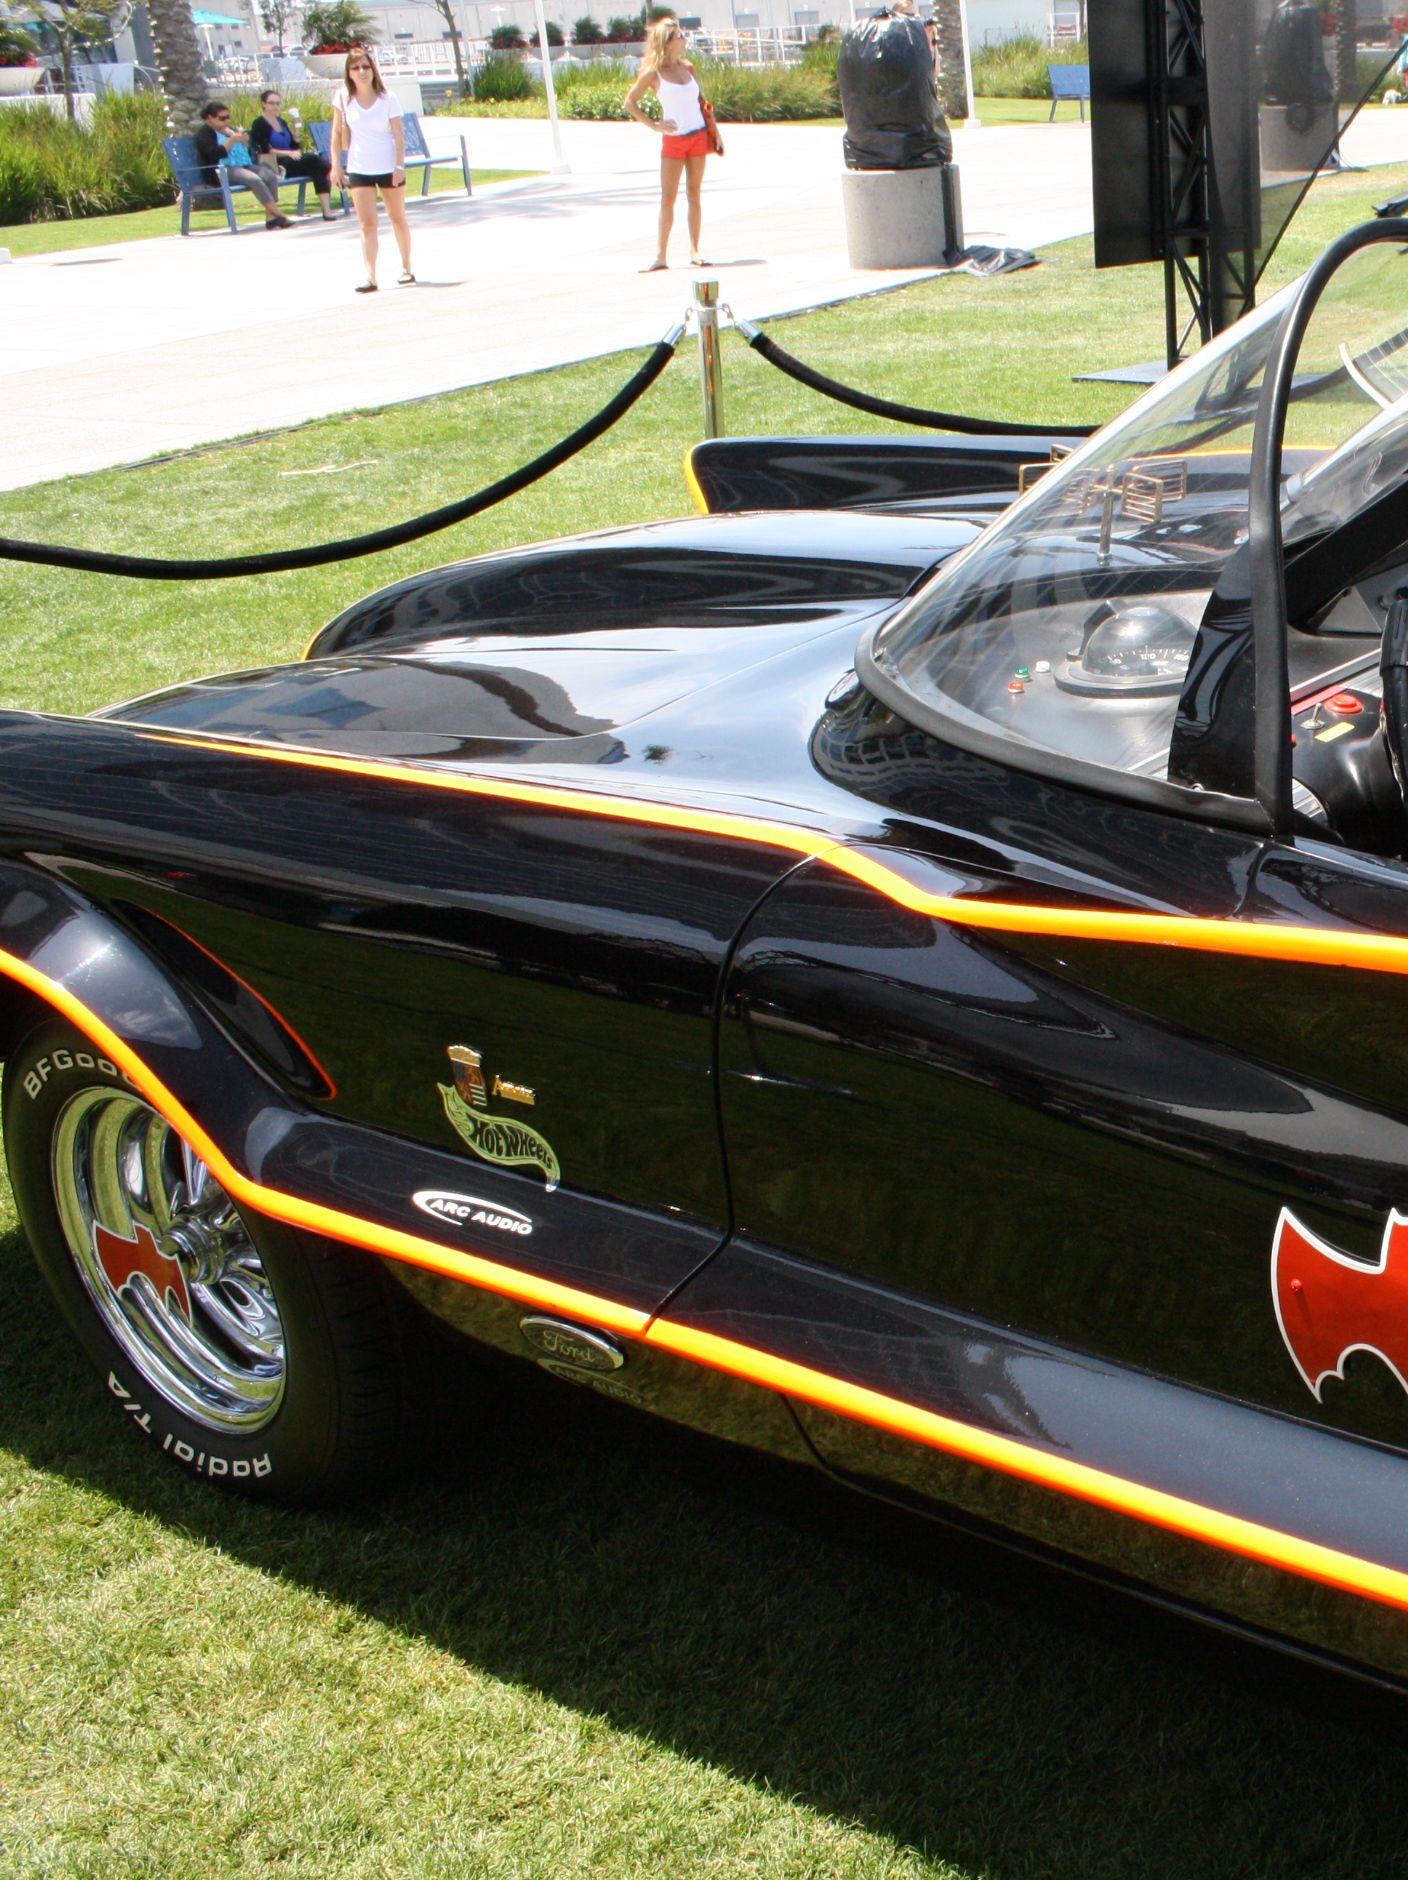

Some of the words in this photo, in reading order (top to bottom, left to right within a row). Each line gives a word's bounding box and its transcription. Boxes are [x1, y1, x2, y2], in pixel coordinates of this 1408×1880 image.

[430, 1198, 471, 1217] ARC
[471, 1210, 533, 1235] AUDIO
[543, 1330, 596, 1362] Ford
[162, 1432, 273, 1479] Radial
